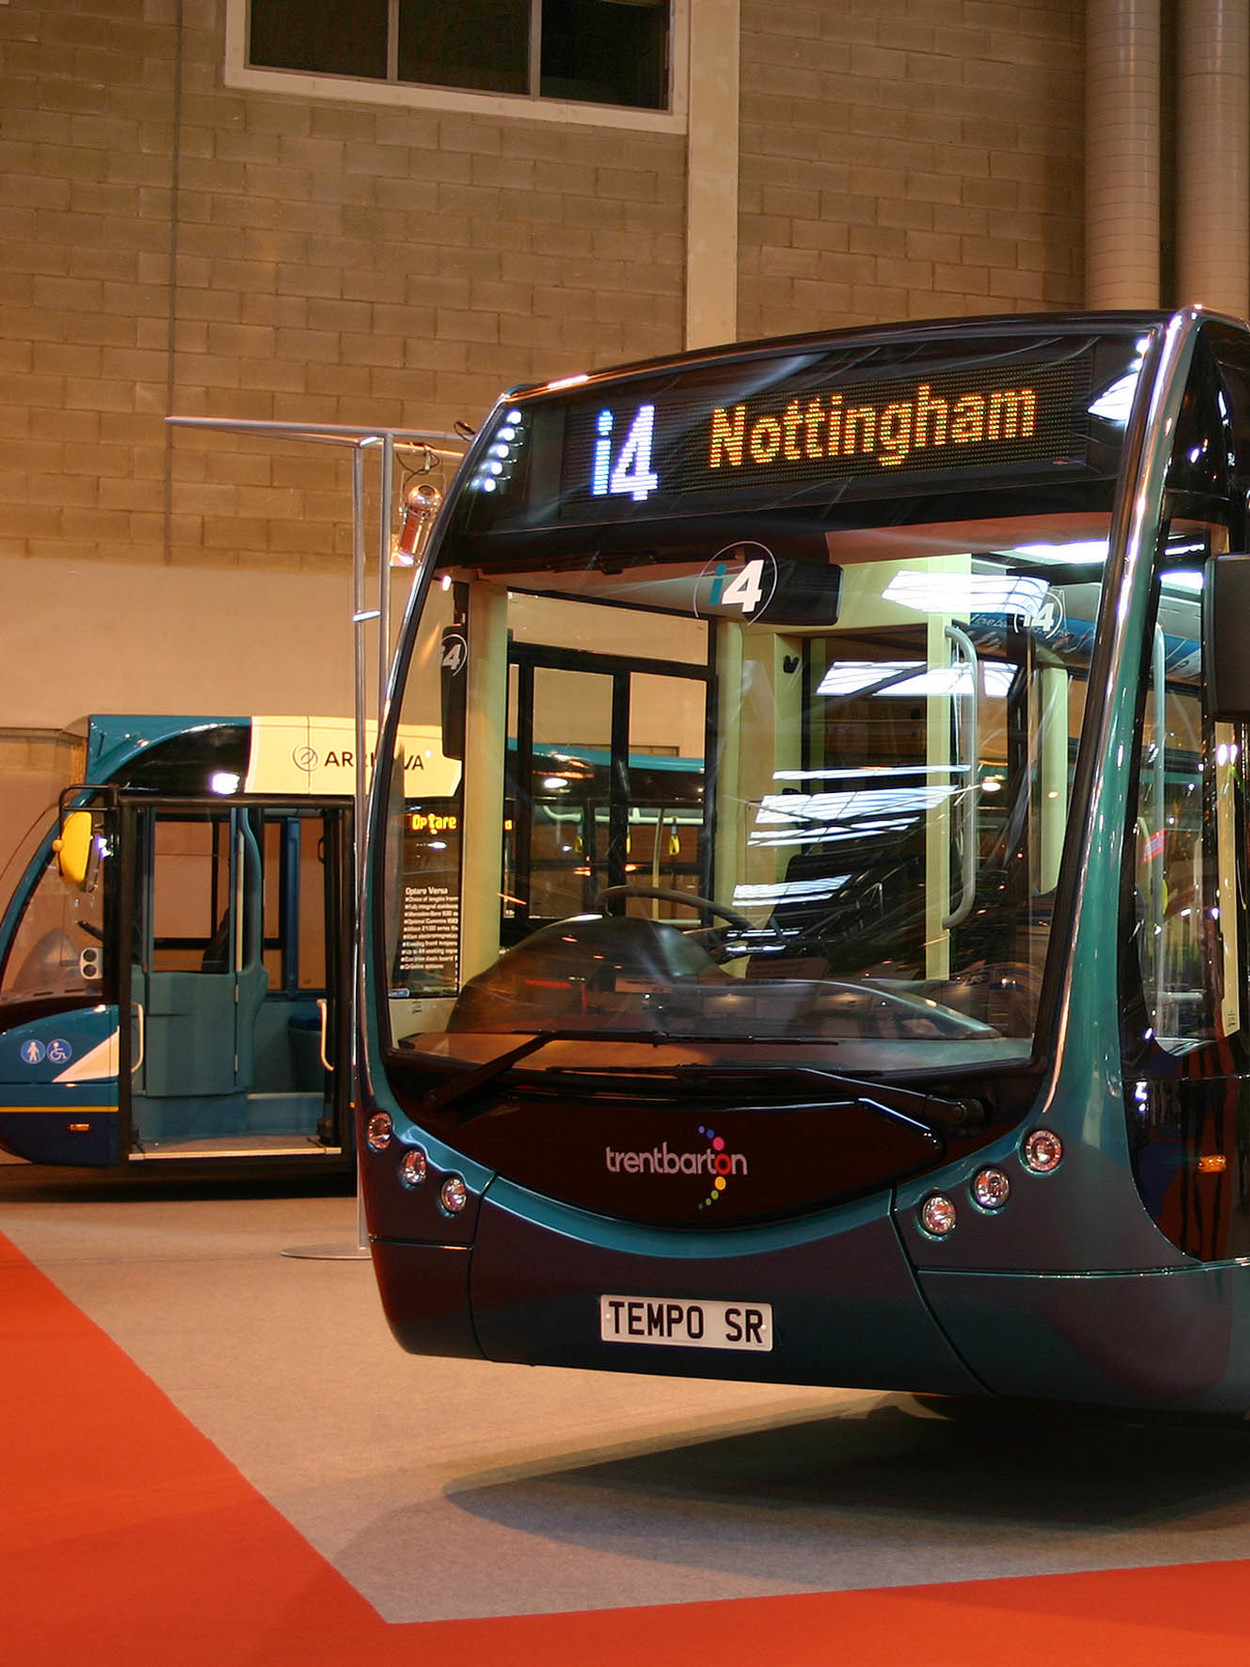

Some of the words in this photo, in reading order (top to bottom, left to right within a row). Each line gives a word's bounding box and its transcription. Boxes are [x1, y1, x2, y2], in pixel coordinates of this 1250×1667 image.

[710, 385, 1036, 467] Nottingham
[592, 405, 658, 500] i4
[709, 560, 764, 612] i4
[412, 813, 457, 830] Optare
[606, 1141, 748, 1175] trentbarton
[609, 1301, 704, 1339] TEMPO
[725, 1308, 763, 1344] SR
